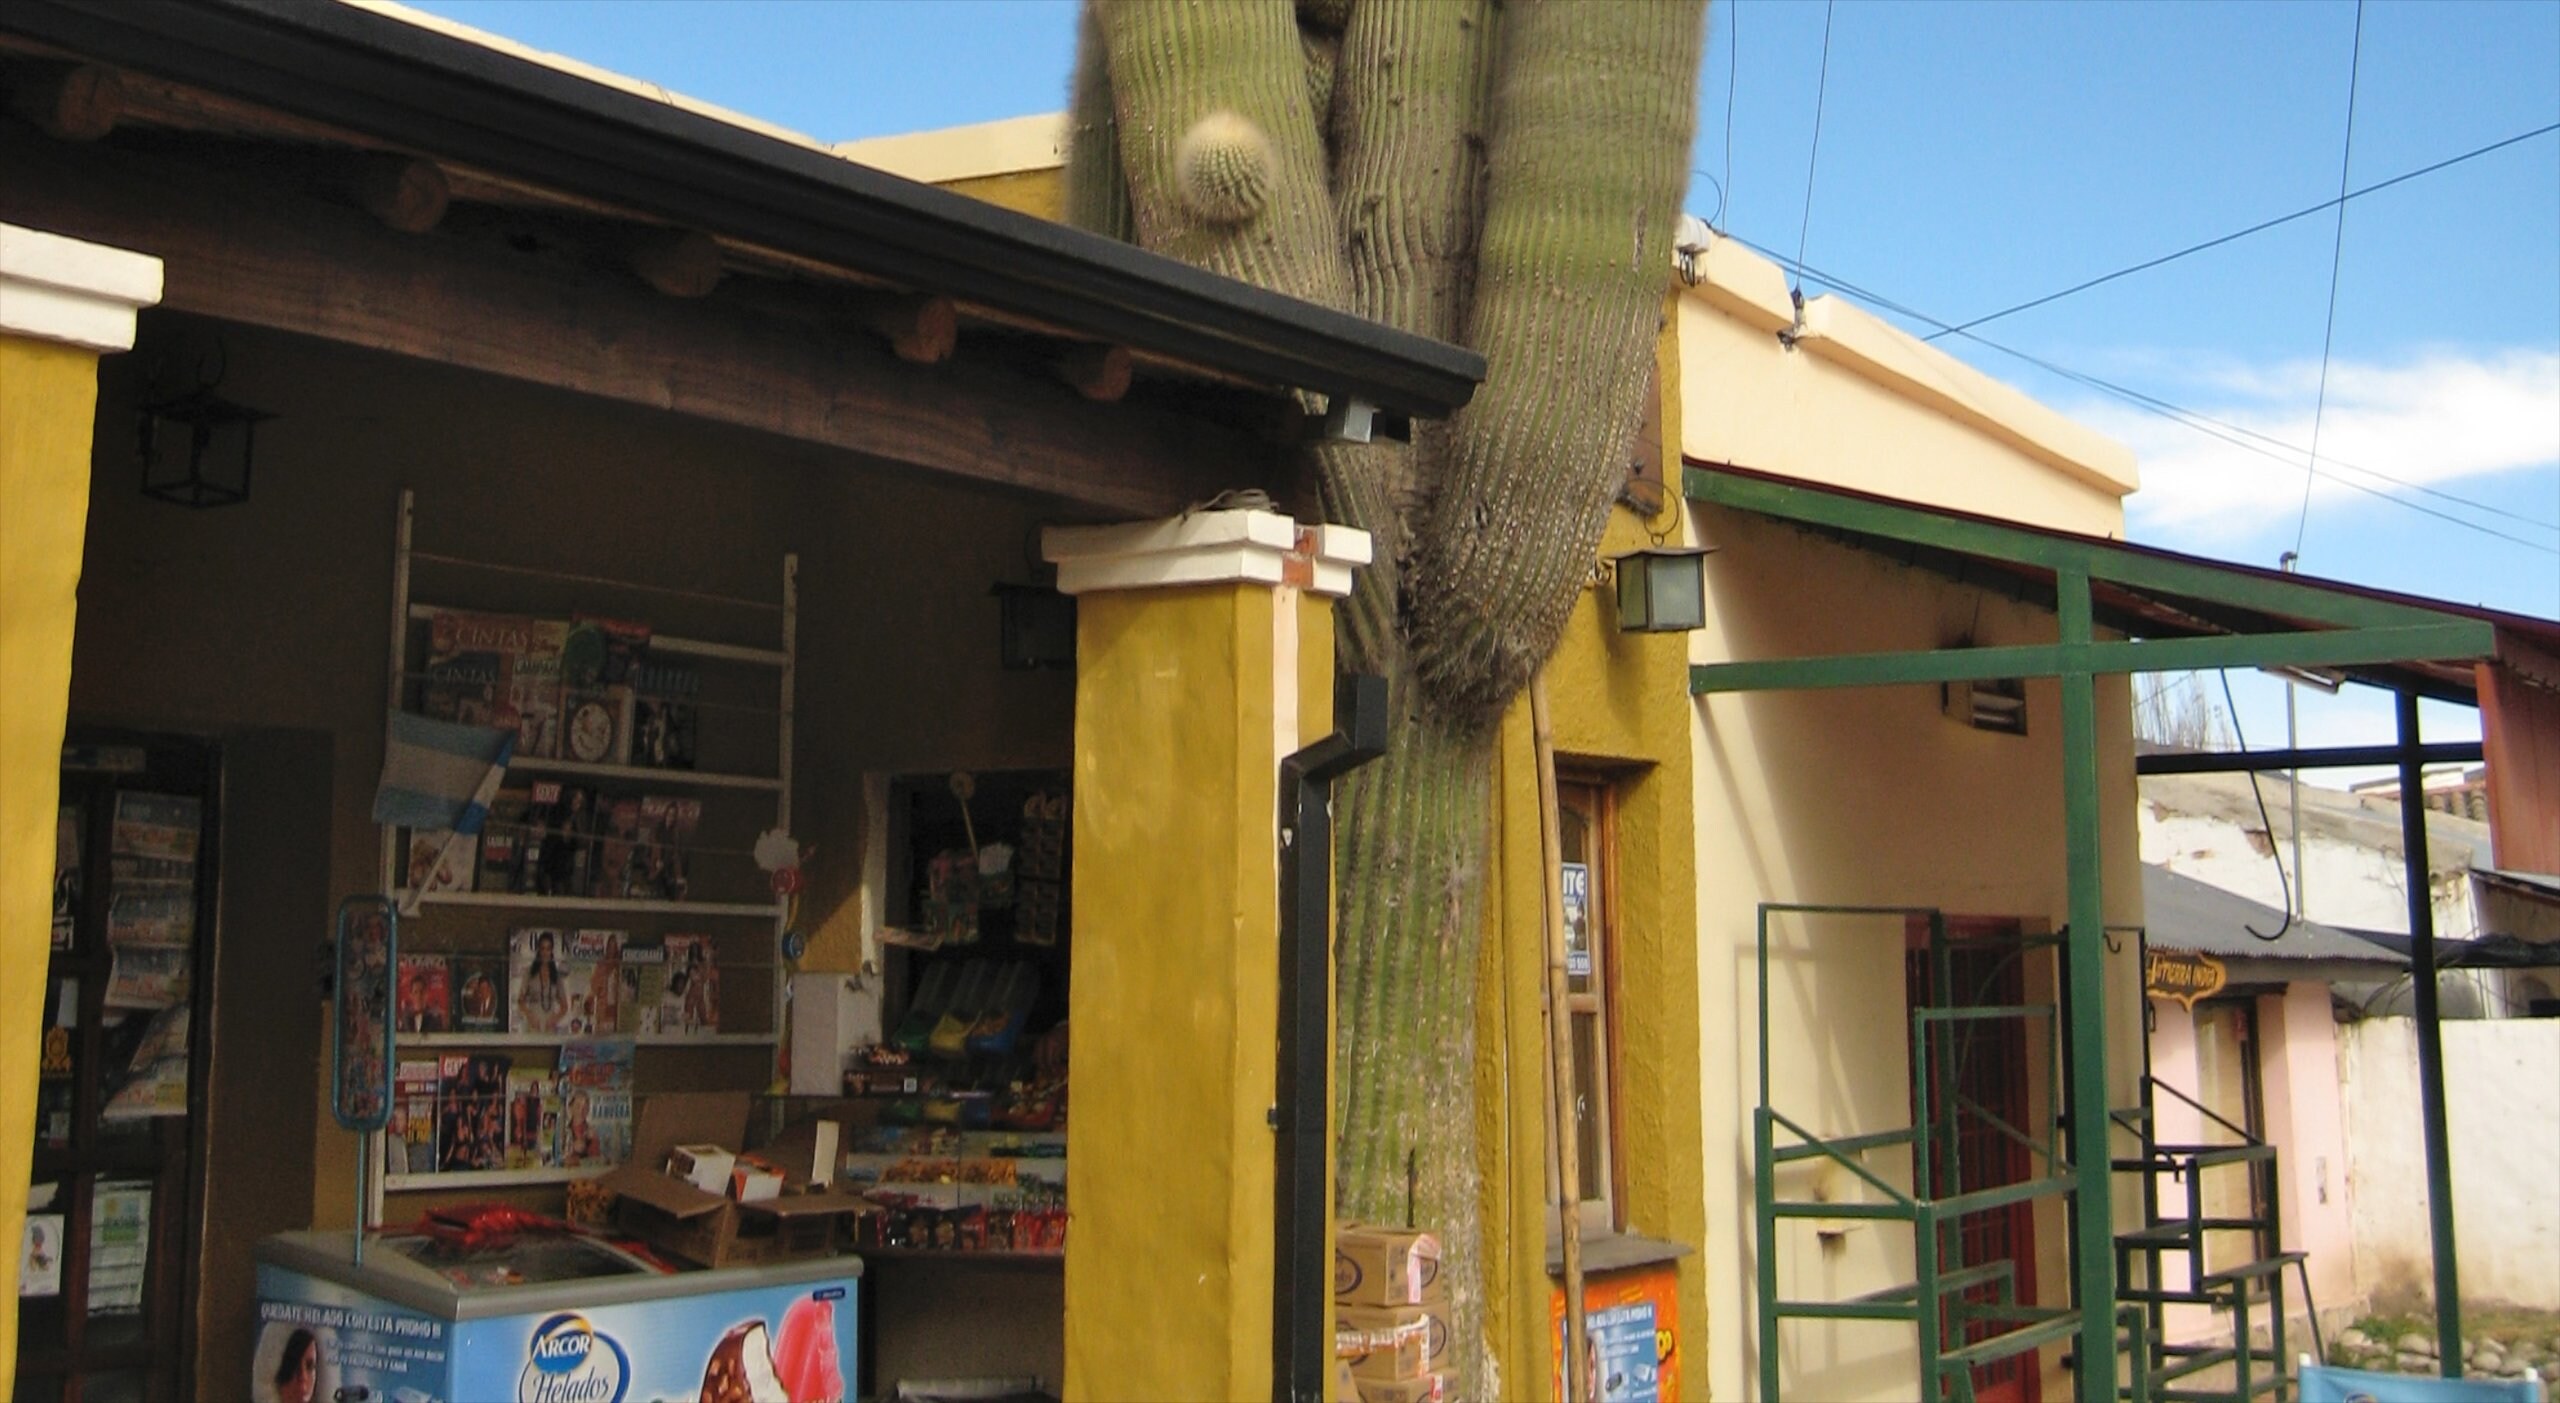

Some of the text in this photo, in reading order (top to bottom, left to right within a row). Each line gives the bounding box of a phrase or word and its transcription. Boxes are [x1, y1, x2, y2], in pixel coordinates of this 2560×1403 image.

[455, 626, 529, 651] CINTAS
[432, 667, 498, 685] CINTAS
[302, 1305, 344, 1328] HELADO
[344, 1311, 367, 1330] CON
[367, 1314, 393, 1334] ESTA
[394, 1318, 432, 1338] PROMO
[532, 1334, 592, 1360] ARCOR
[533, 1366, 610, 1403] Helados
